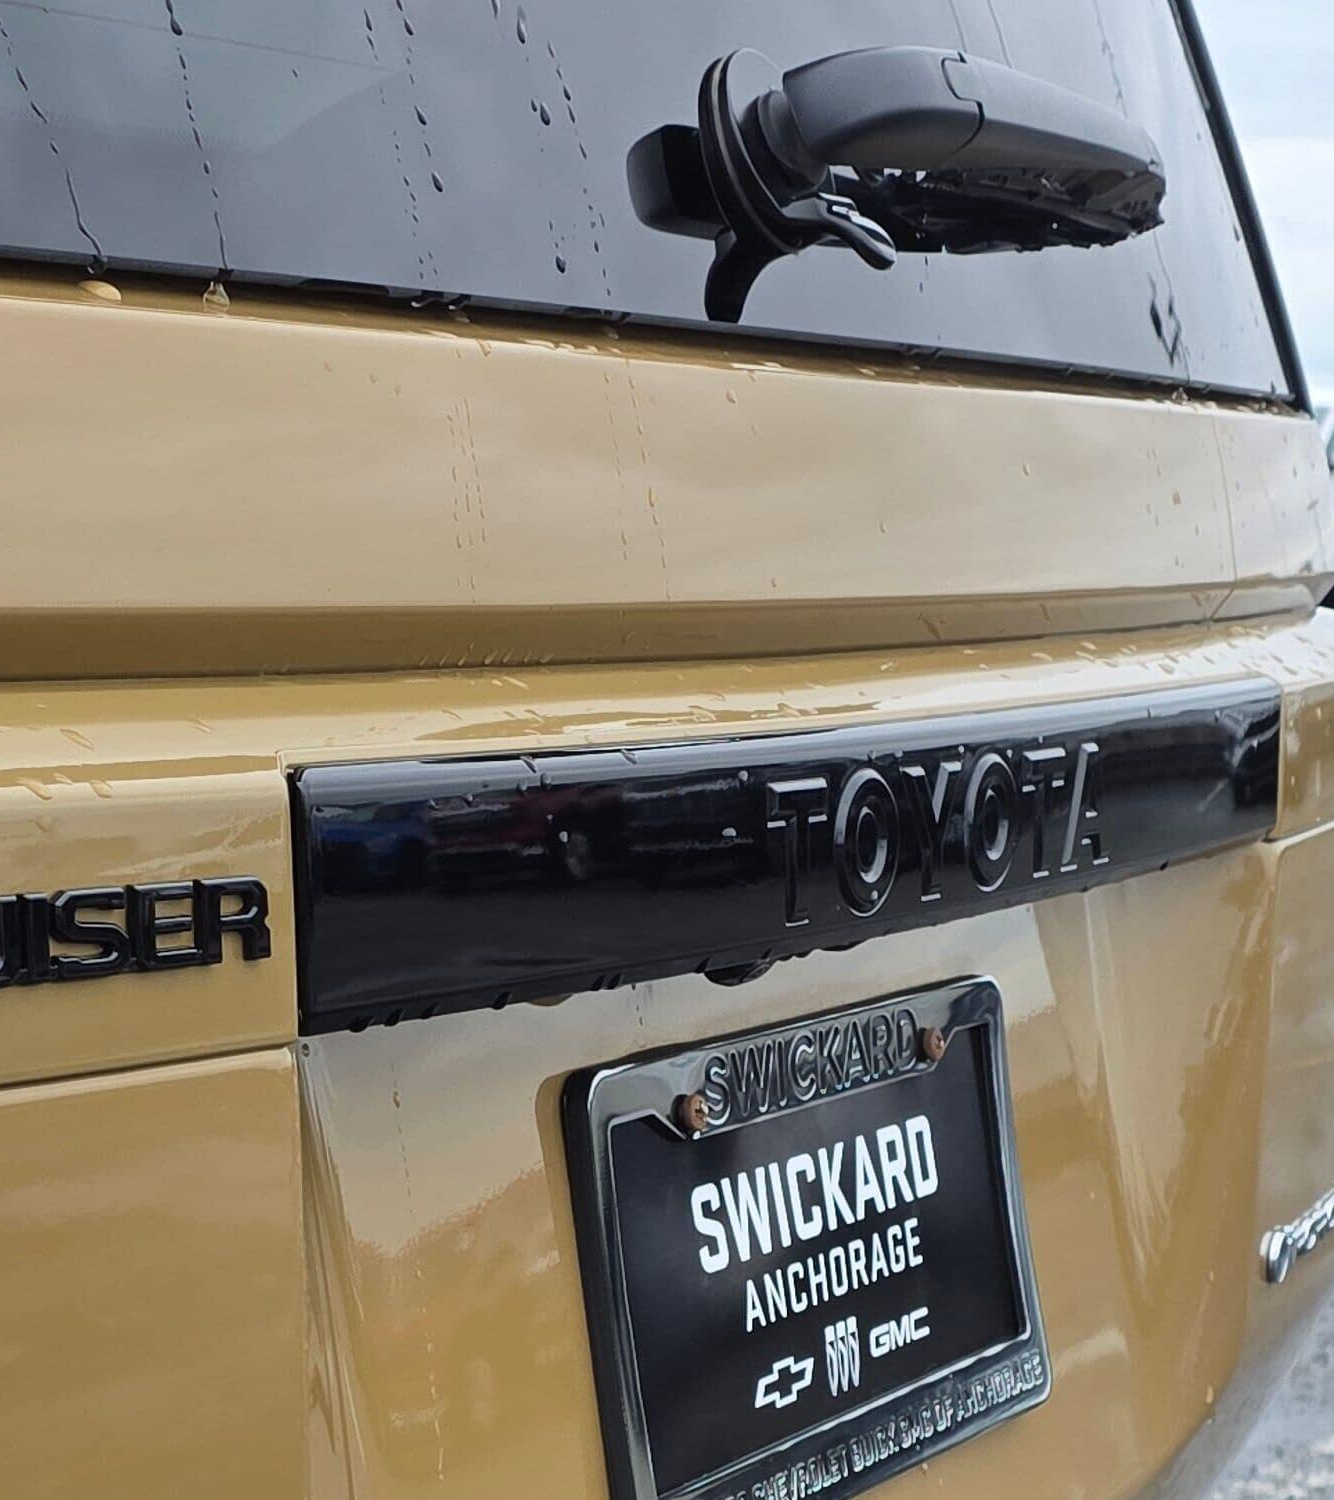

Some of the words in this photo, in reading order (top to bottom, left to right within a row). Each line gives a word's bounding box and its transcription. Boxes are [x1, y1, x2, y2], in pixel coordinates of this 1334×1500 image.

[765, 741, 1110, 927] TOYOTA
[703, 1007, 918, 1127] SWICKARD
[690, 1114, 939, 1275] SWICKARD
[744, 1217, 924, 1333] ANCHORAGE
[868, 1306, 931, 1358] GMC
[850, 1415, 900, 1473] BUICK
